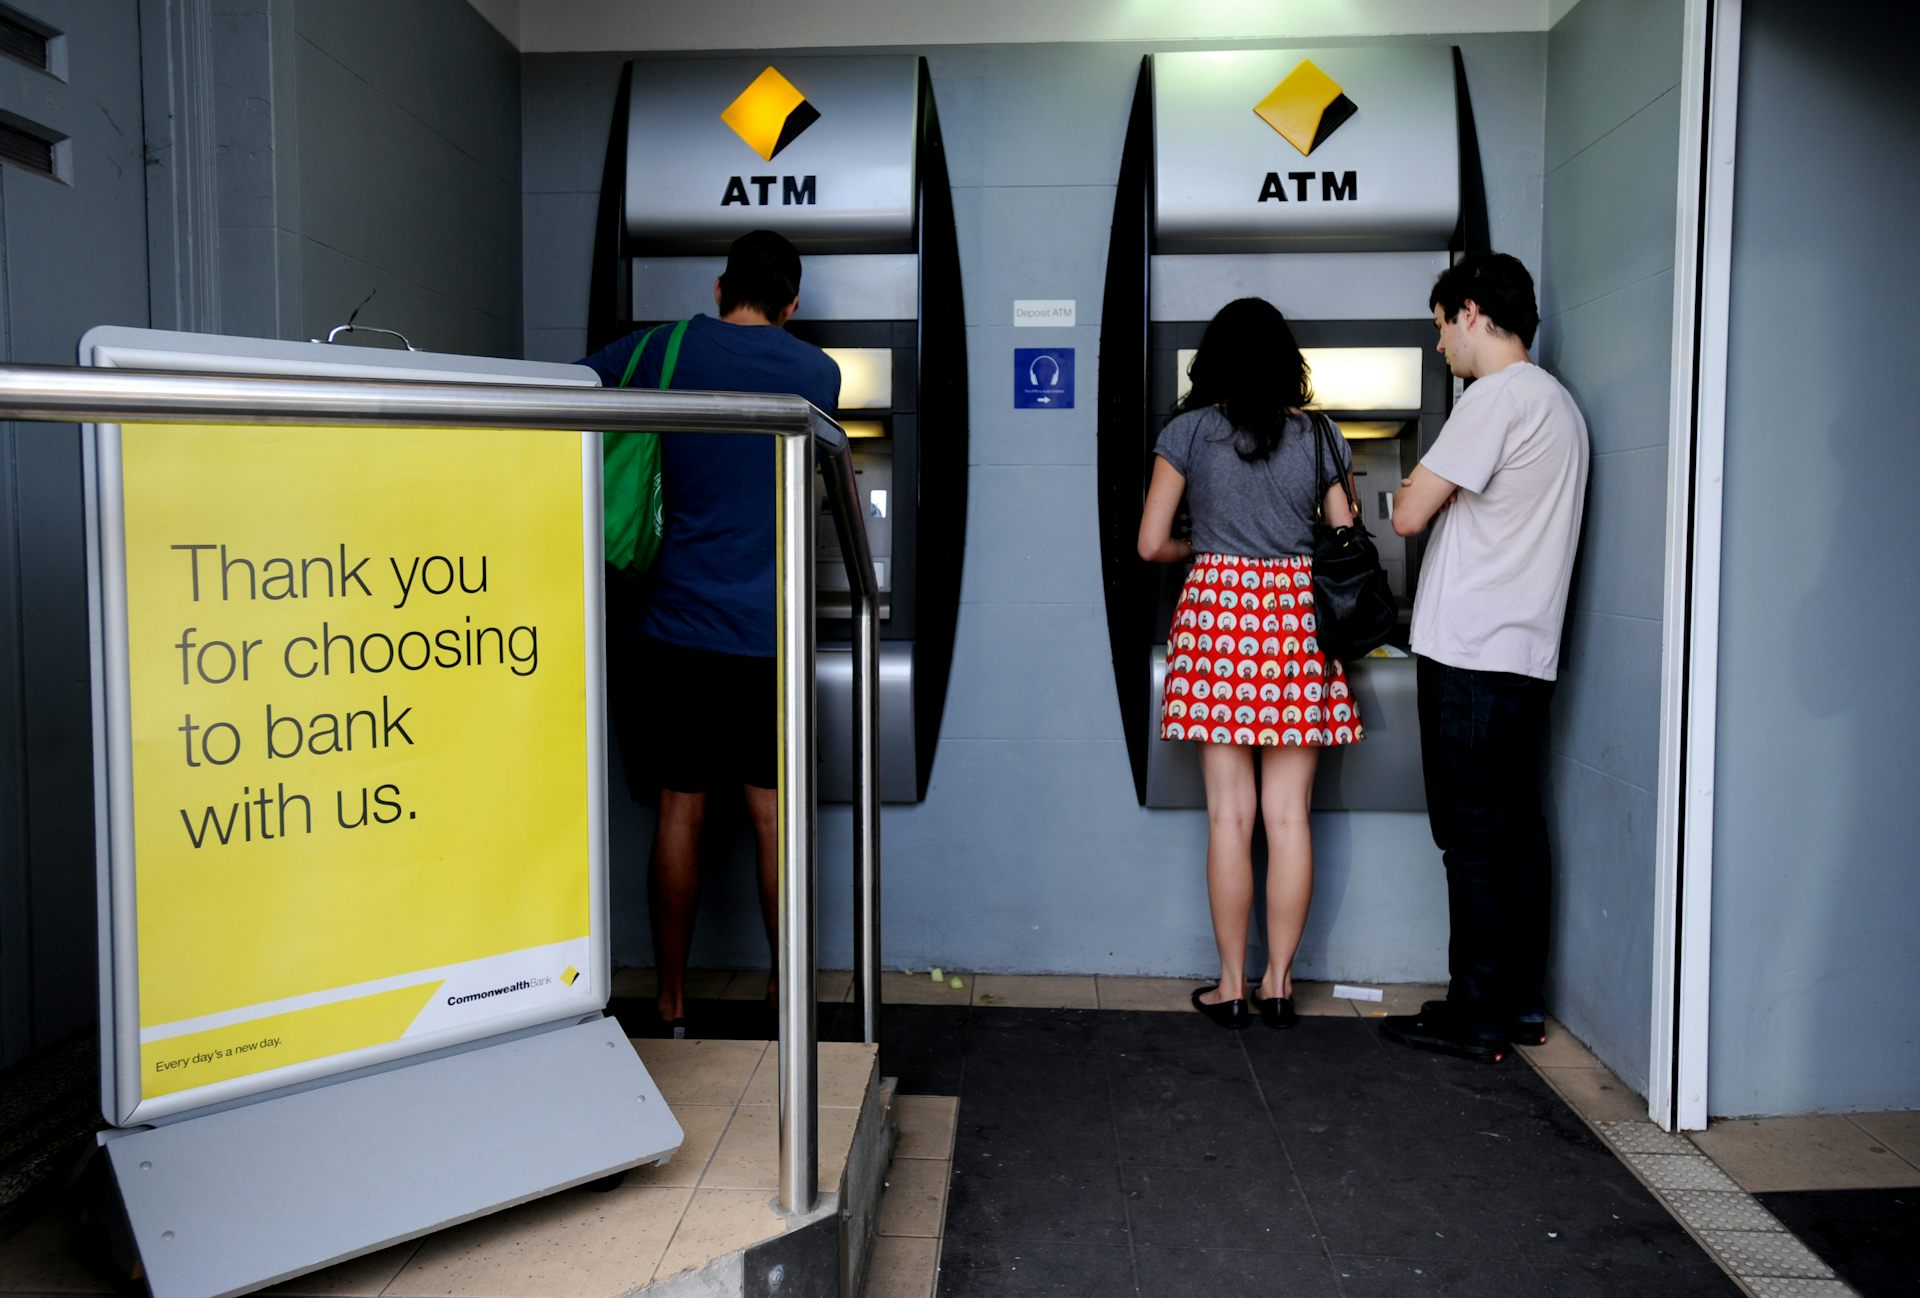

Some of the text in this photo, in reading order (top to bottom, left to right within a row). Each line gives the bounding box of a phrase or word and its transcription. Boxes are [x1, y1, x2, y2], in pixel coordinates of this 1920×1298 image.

[720, 175, 816, 206] ATM
[1258, 171, 1358, 202] ATM
[1016, 308, 1072, 319] Deposit ATM
[170, 543, 488, 609] Thank you
[174, 615, 538, 685] for choosing
[177, 695, 414, 768] to bank
[179, 782, 417, 850] with us.
[156, 1037, 282, 1073] Every day's a new day.
